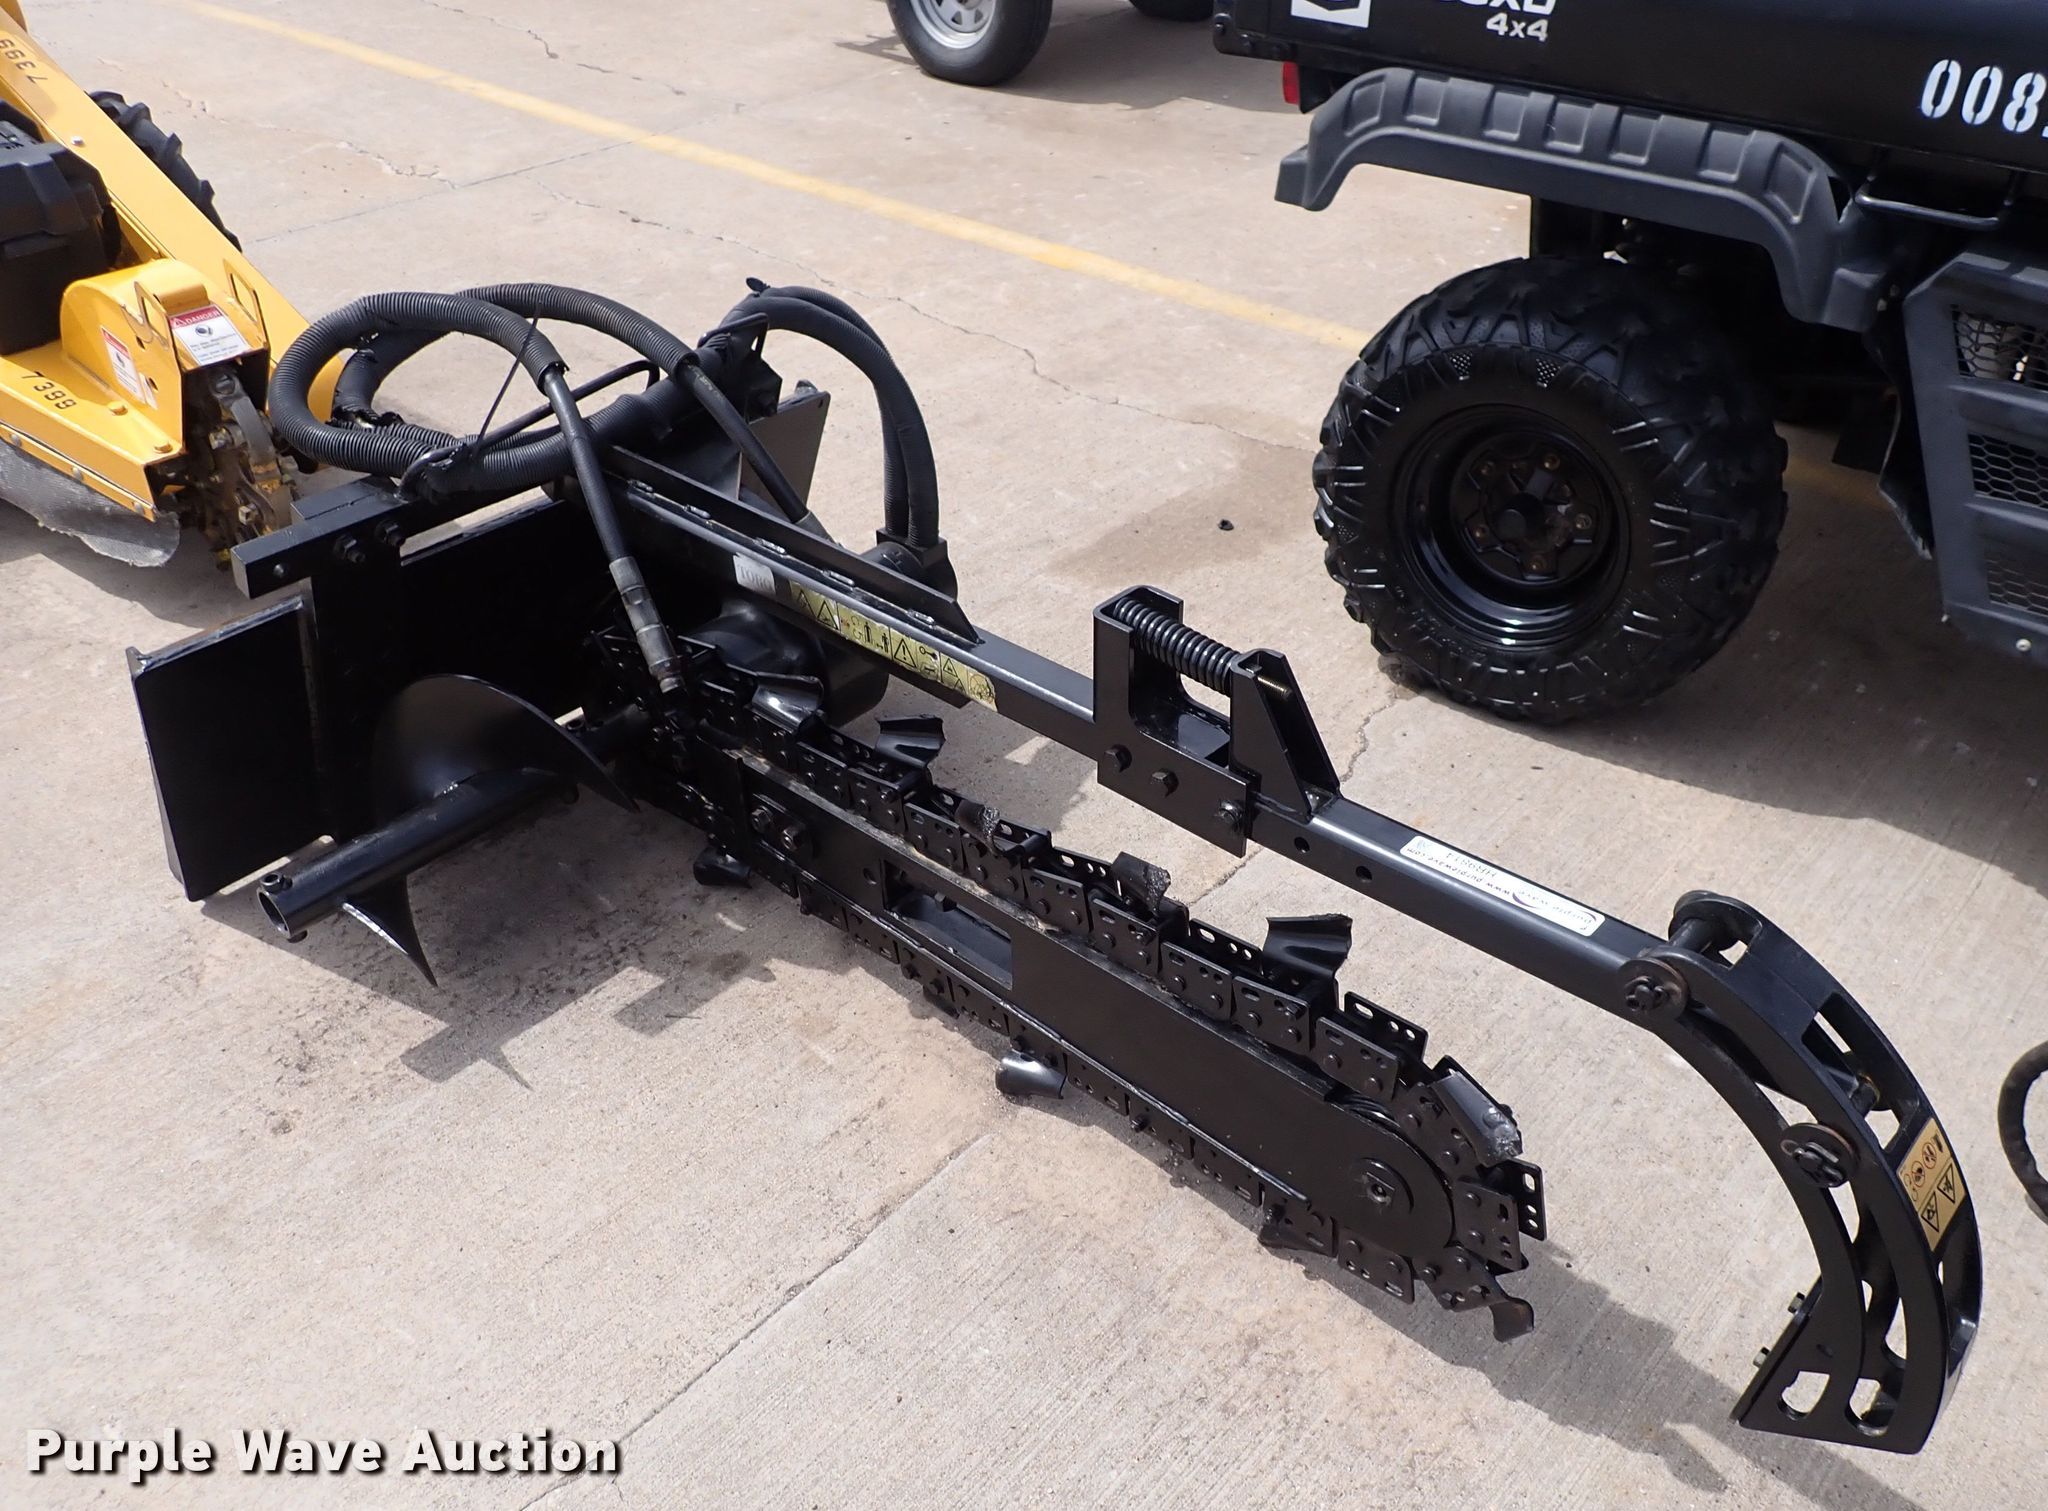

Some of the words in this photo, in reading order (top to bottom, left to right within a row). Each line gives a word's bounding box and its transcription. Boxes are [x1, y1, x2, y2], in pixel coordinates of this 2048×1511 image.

[1486, 12, 1549, 42] 4x4
[0, 39, 48, 84] 7399
[1921, 59, 2048, 138] 008
[21, 371, 77, 409] 7399
